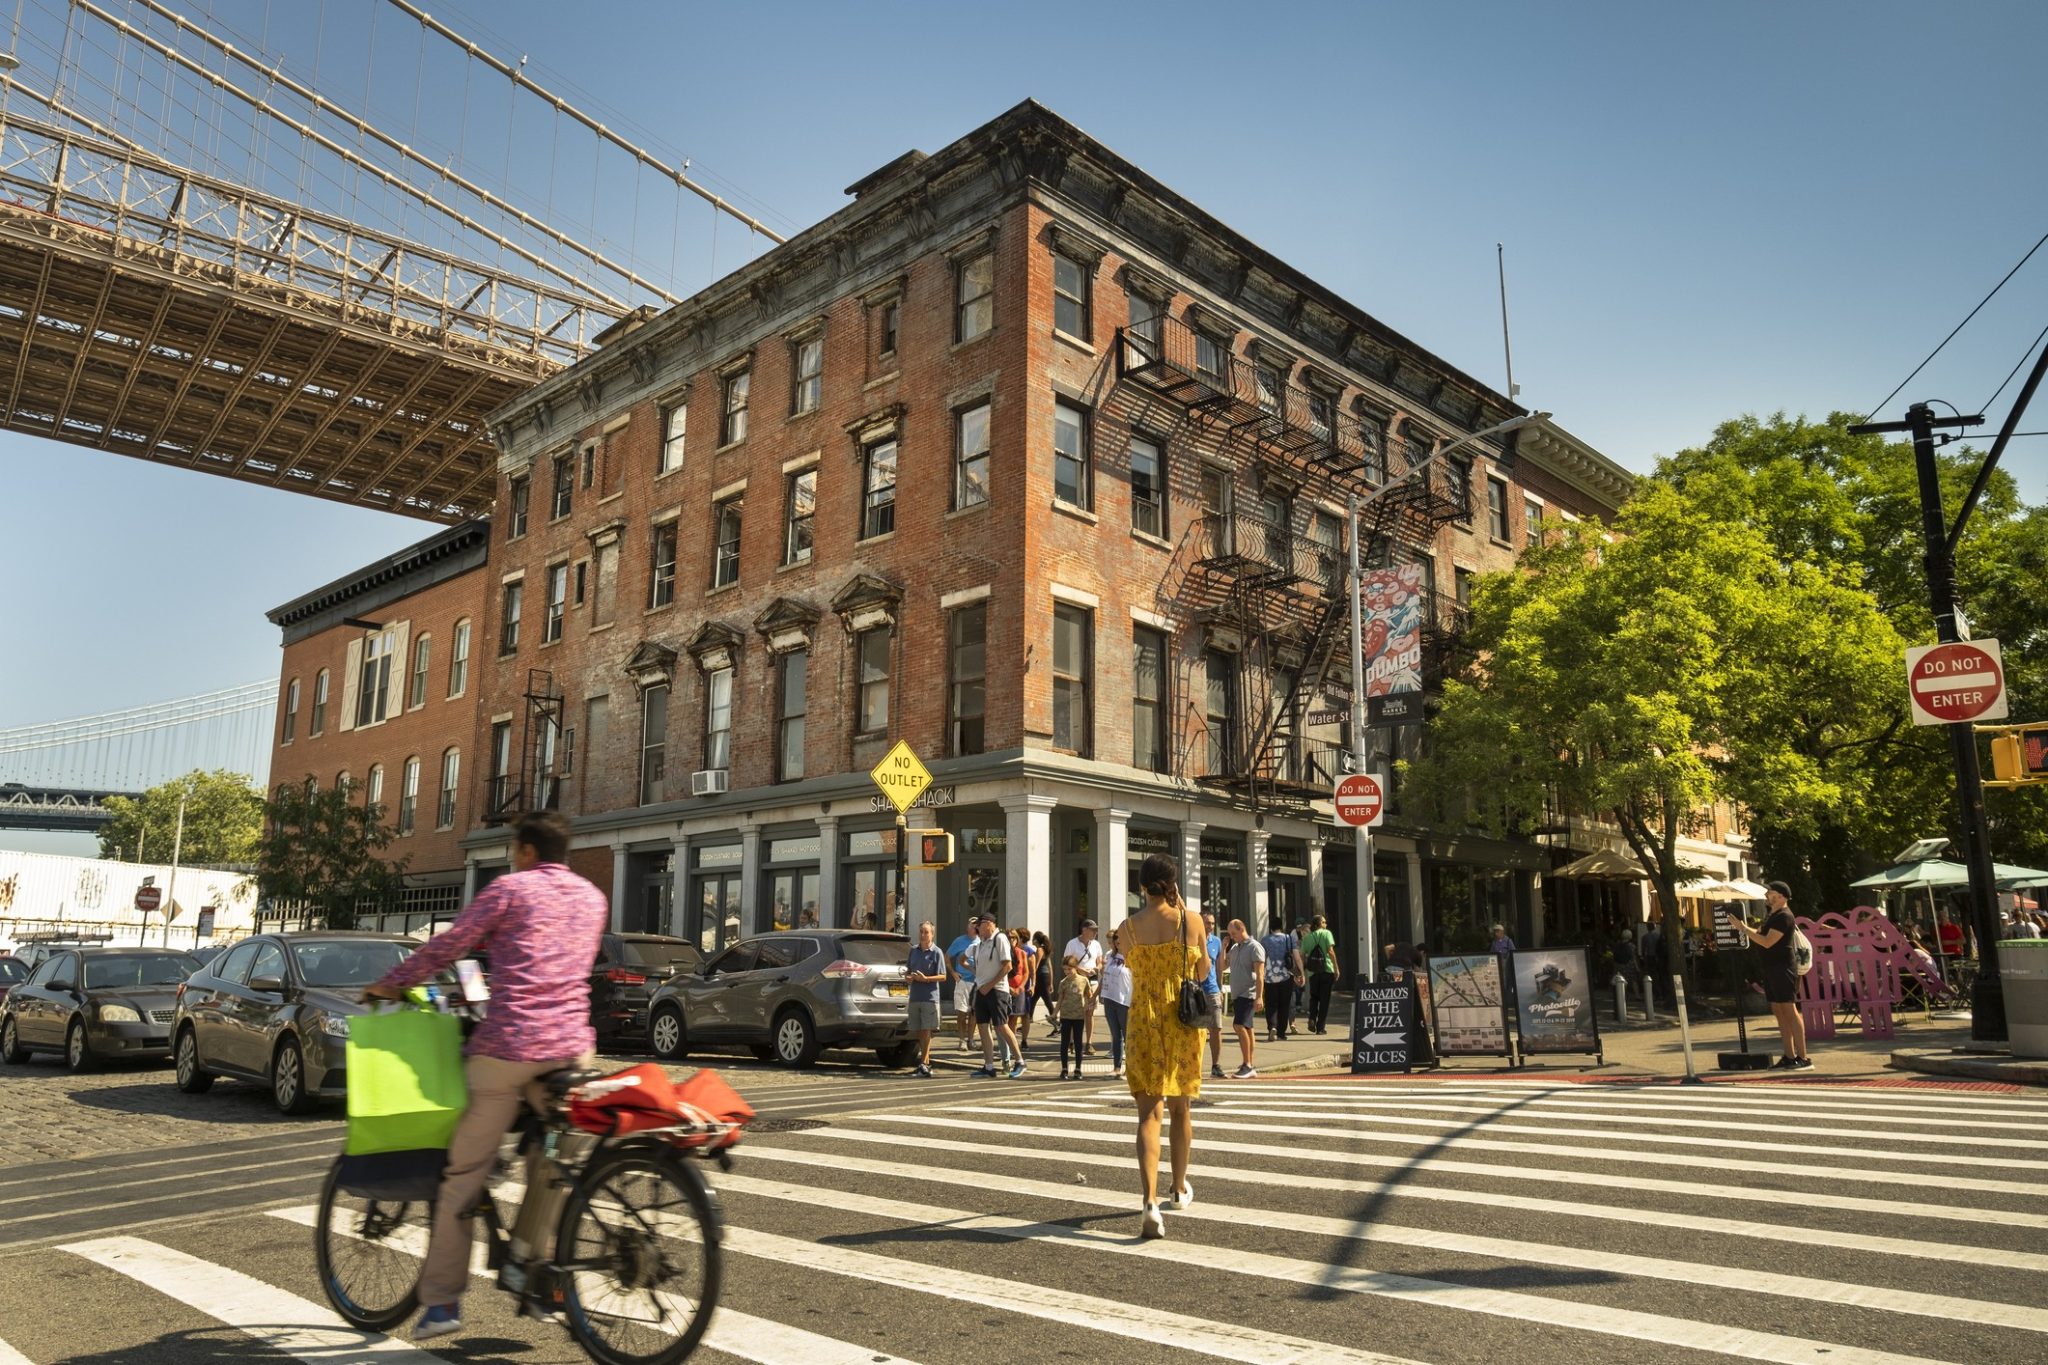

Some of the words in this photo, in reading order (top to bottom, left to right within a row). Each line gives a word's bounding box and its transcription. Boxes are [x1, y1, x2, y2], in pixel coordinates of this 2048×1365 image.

[1366, 647, 1421, 683] DUMBO
[1924, 661, 1945, 674] DO
[1952, 657, 1982, 671] NOT
[1932, 691, 1983, 708] ENTER
[1309, 714, 1336, 725] Water
[1340, 711, 1349, 721] St
[894, 756, 910, 769] NO
[880, 773, 924, 787] OUTLET
[1341, 785, 1354, 794] DO
[1358, 785, 1375, 793] NOT
[870, 796, 897, 812] SHA
[1344, 807, 1372, 816] ENTER
[1361, 987, 1409, 999] IGNAZIO'S
[1368, 1001, 1400, 1014] THE
[1528, 997, 1581, 1014] Photoville
[1363, 1015, 1404, 1028] PIZZA
[1358, 1050, 1407, 1064] SLICES
